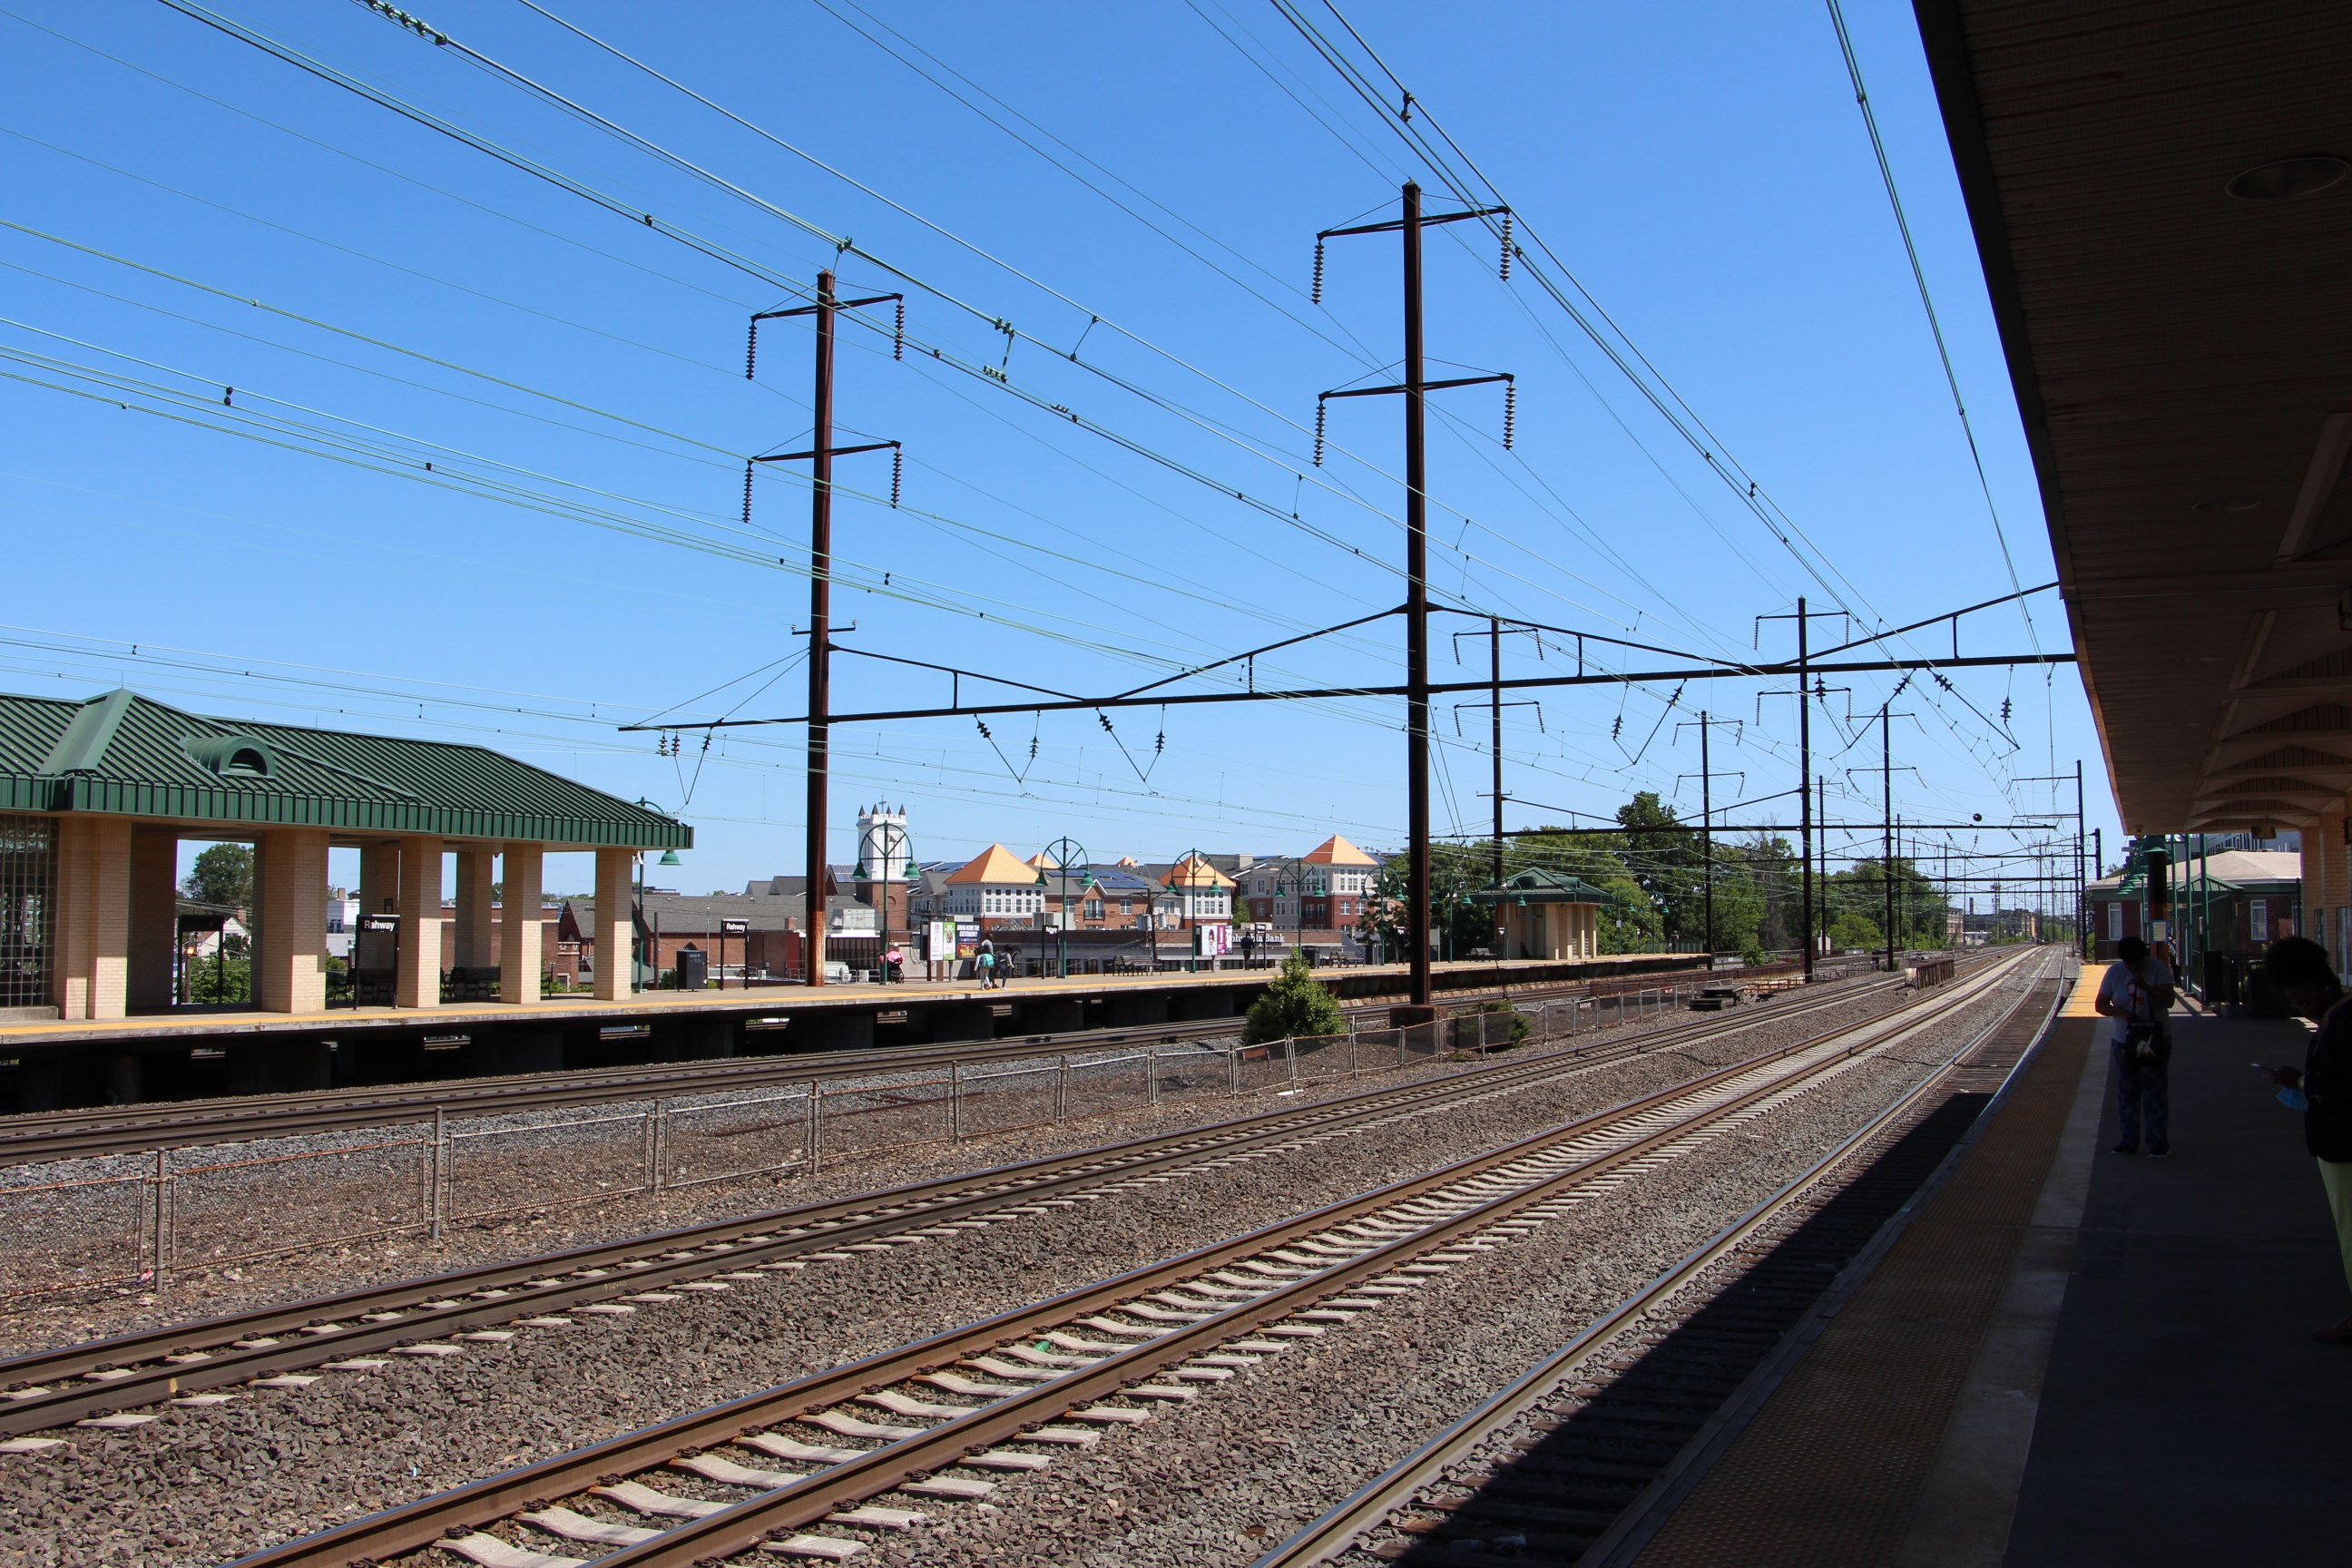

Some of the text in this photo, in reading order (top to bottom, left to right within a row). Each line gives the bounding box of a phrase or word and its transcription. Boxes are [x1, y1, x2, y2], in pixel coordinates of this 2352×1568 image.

[364, 920, 395, 932] Rahway
[726, 923, 746, 932] Rahway
[1231, 933, 1264, 943] olubia
[1266, 933, 1285, 943] Bank
